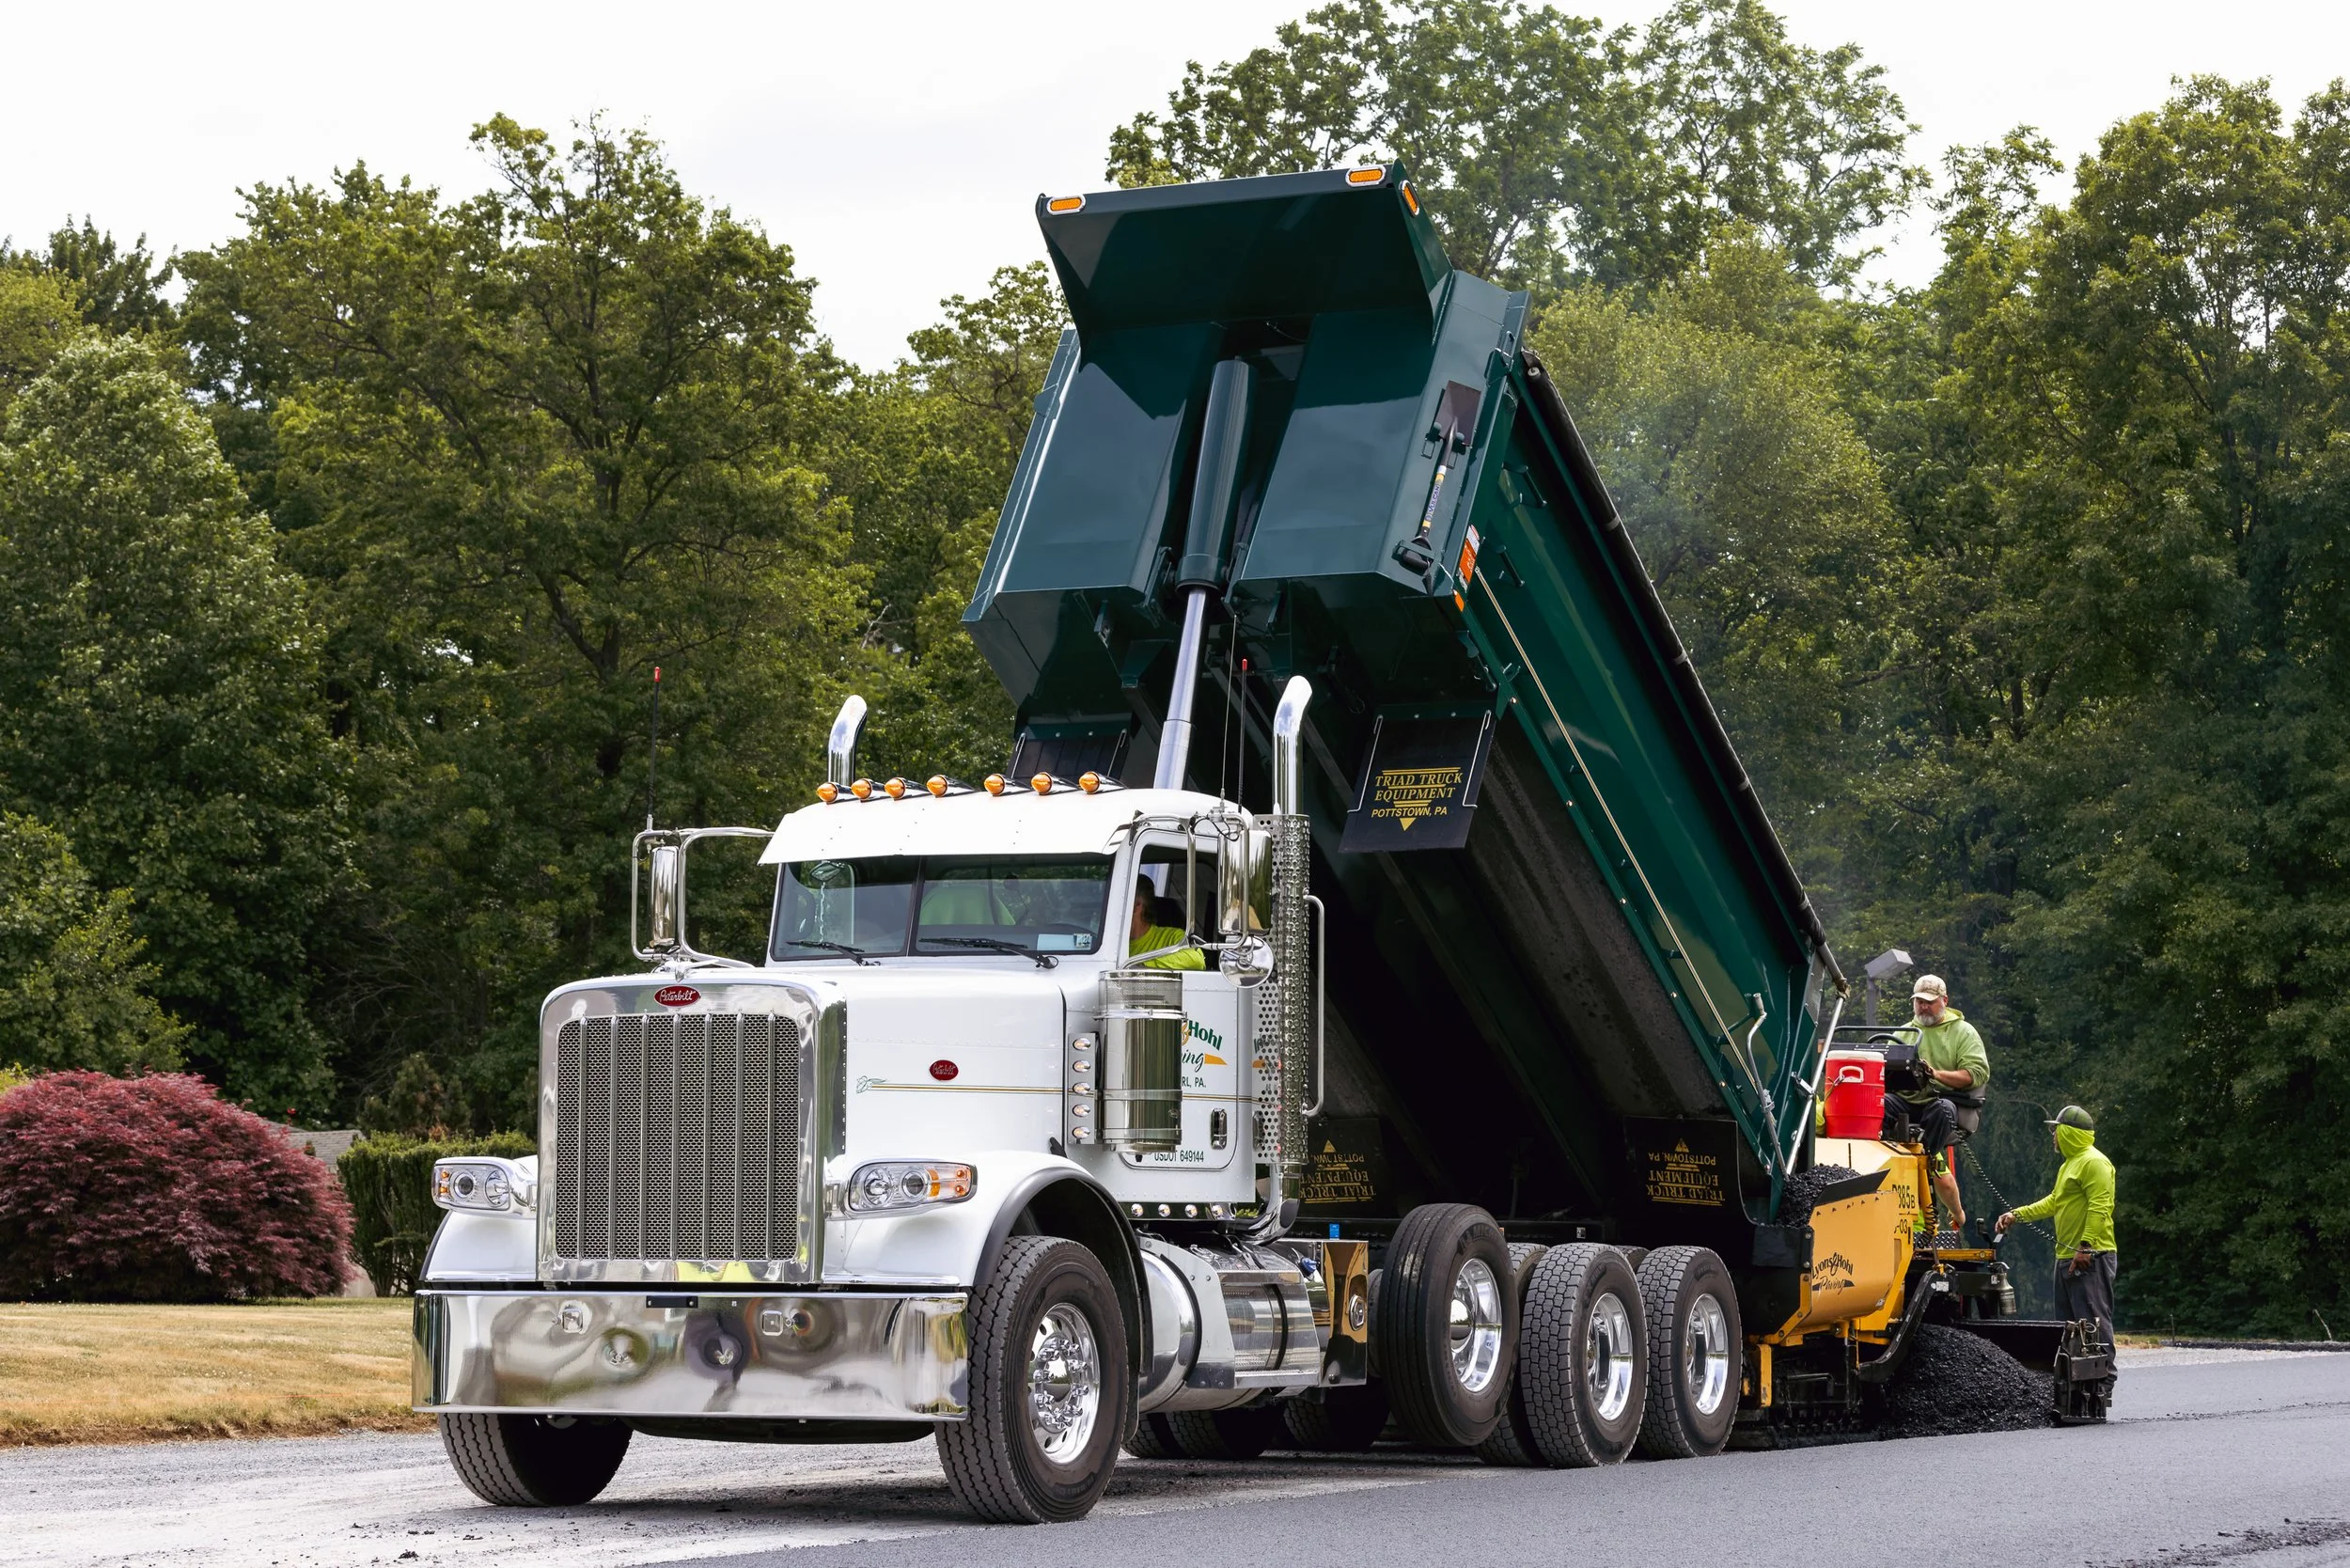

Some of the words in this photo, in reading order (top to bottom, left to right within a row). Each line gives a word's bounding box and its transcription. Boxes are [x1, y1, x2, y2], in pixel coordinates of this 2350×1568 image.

[1428, 485, 1440, 512] VULCAN
[1374, 774, 1416, 787] TRIAD
[1419, 773, 1464, 785] TRUCK
[1374, 787, 1456, 802] EQUIPMENT
[1371, 807, 1432, 818] POTTSTOWN,
[1434, 806, 1448, 816] PA
[660, 989, 697, 1003] Peterbilt
[1188, 1019, 1223, 1051] Hohl
[1181, 1049, 1204, 1074] ing
[1181, 1075, 1192, 1089] RL,
[1194, 1076, 1207, 1088] PA.
[1153, 1151, 1177, 1162] USDOT
[1180, 1150, 1204, 1163] 649144
[1648, 1152, 1660, 1162] PA
[1662, 1152, 1716, 1166] POTTSTOWN,
[1648, 1169, 1719, 1186] EQUIPMENT
[1299, 1186, 1338, 1199] TRUCK
[1645, 1184, 1685, 1199] TRUCK
[1688, 1186, 1726, 1201] TRIAD
[1838, 1253, 1854, 1276] Hohl
